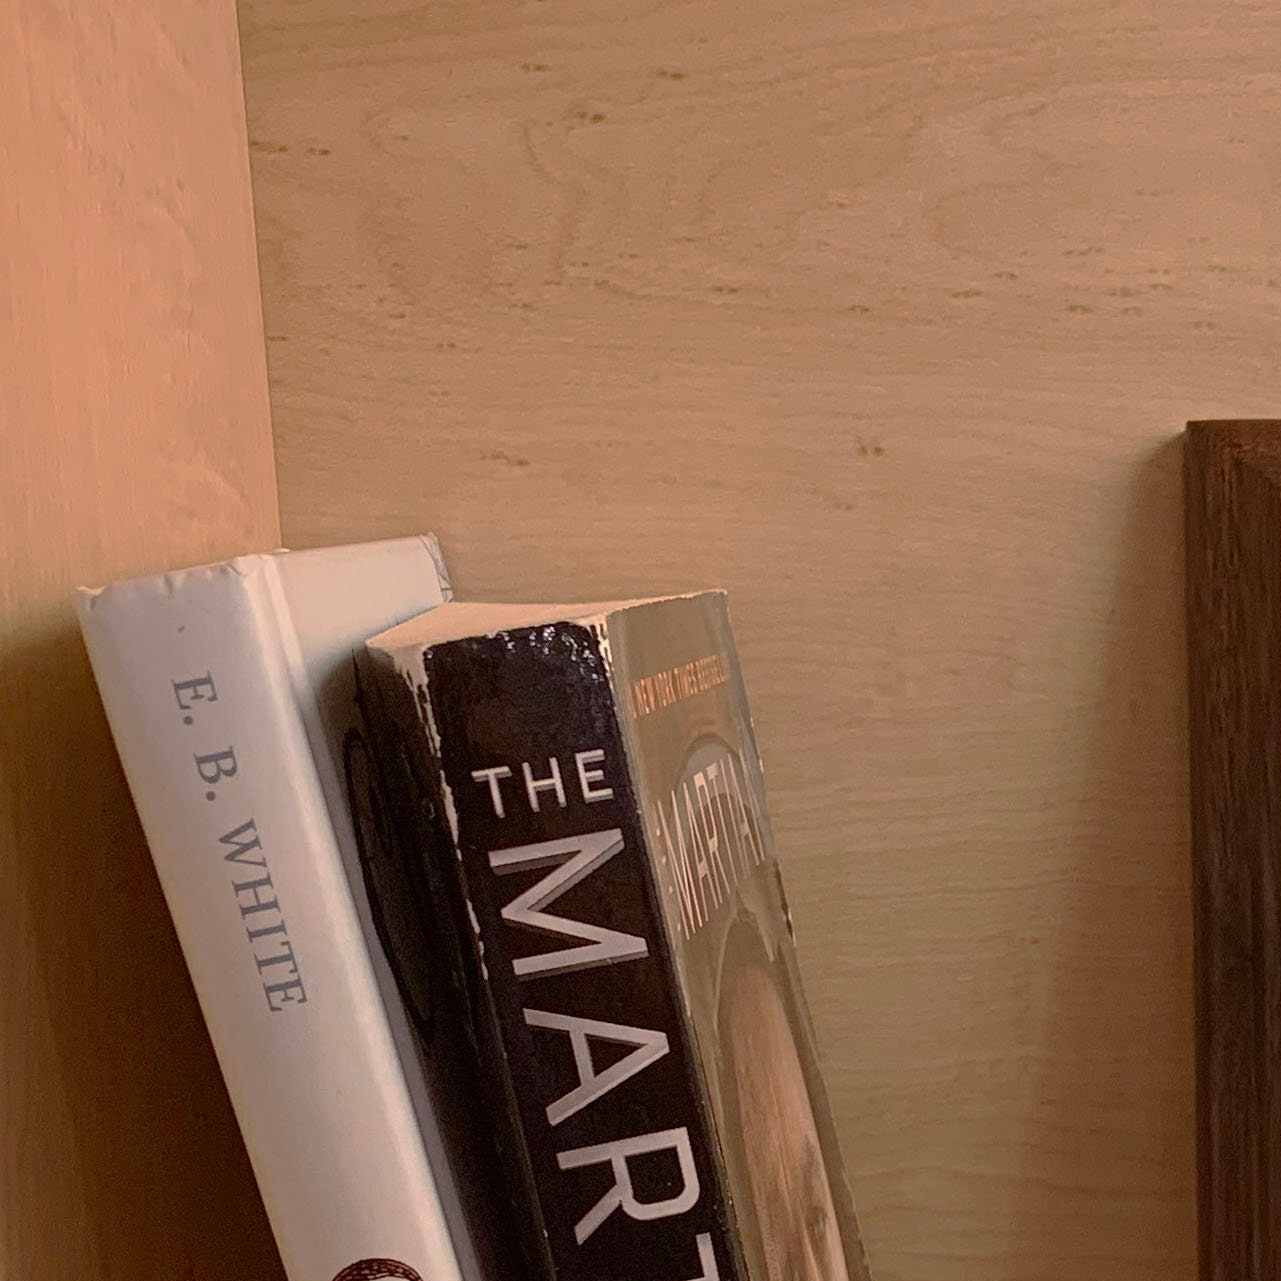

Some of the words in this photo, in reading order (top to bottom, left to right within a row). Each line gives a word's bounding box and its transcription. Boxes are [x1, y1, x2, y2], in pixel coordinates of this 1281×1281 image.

[171, 671, 218, 726] E.
[194, 745, 238, 801] B.
[471, 749, 614, 818] THE
[219, 817, 308, 1012] WHITE
